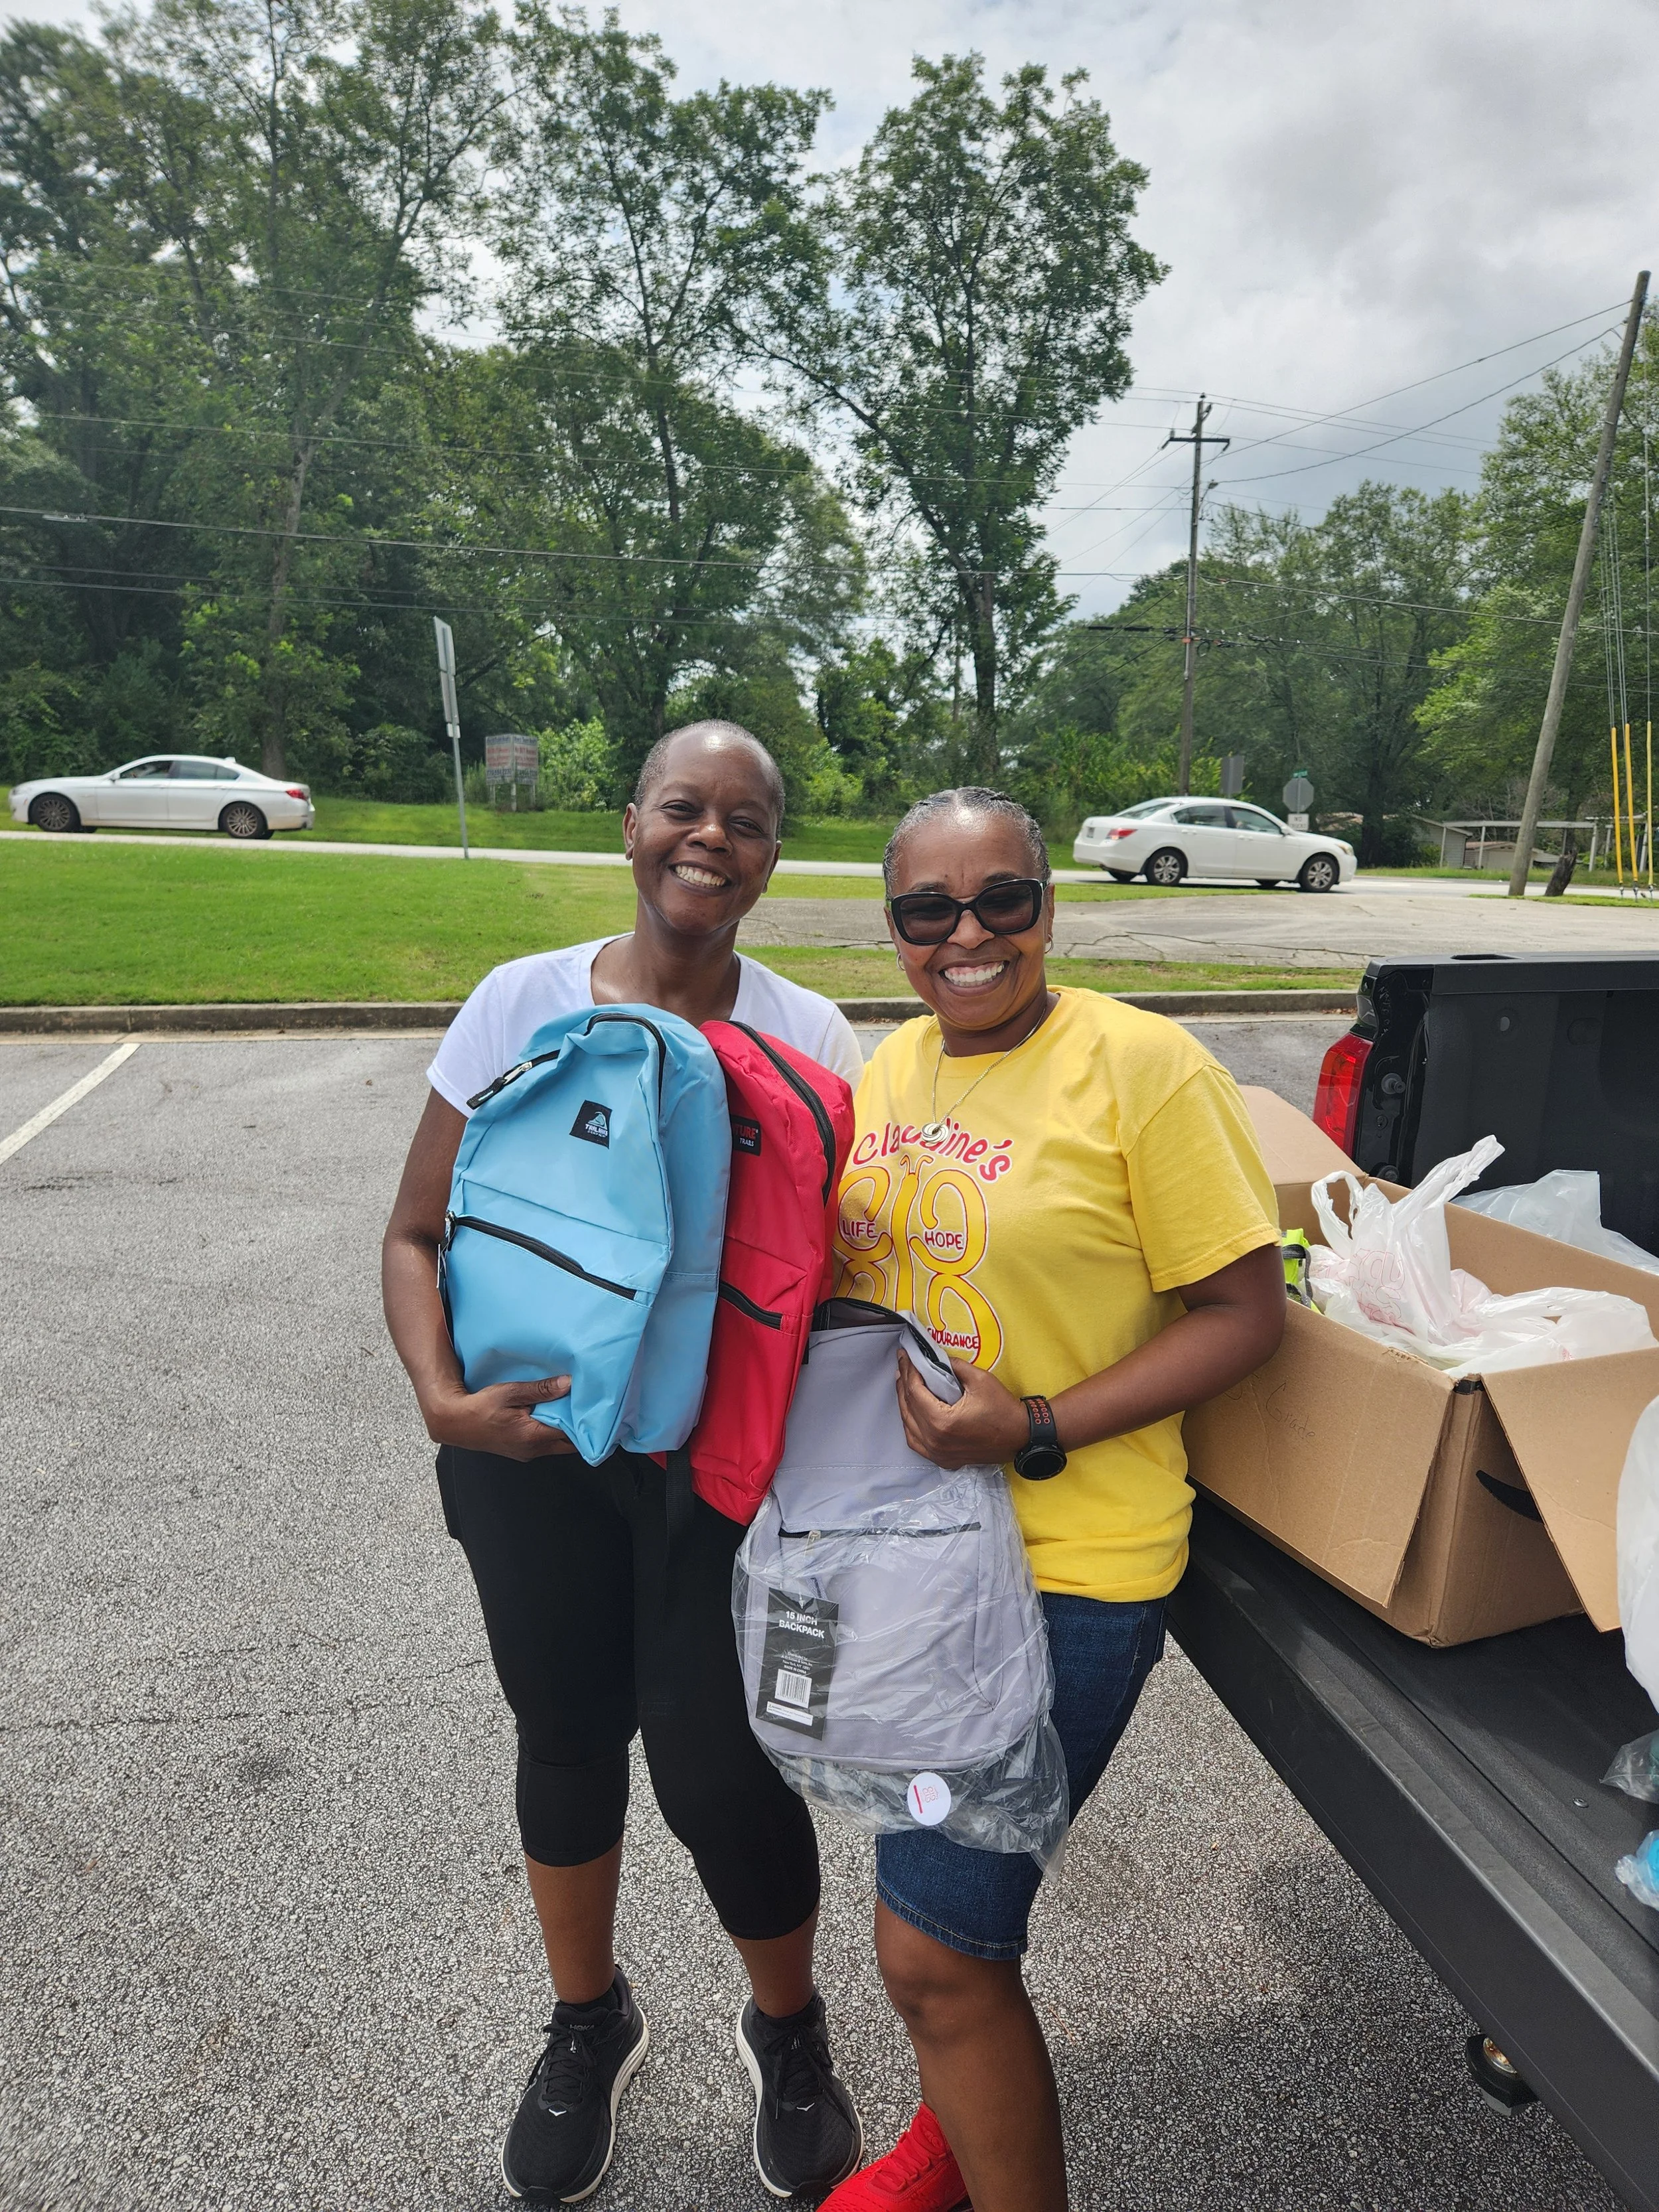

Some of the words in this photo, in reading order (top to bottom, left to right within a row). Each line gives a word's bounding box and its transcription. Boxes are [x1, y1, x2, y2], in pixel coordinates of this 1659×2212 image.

[739, 1138, 755, 1147] TRAILS
[841, 1220, 878, 1240] LIFE
[924, 1231, 964, 1250] HOPE
[1265, 1382, 1315, 1439] Grade
[786, 1611, 795, 1619] 15
[796, 1613, 818, 1626] INCH
[779, 1619, 825, 1639] BACKPACK
